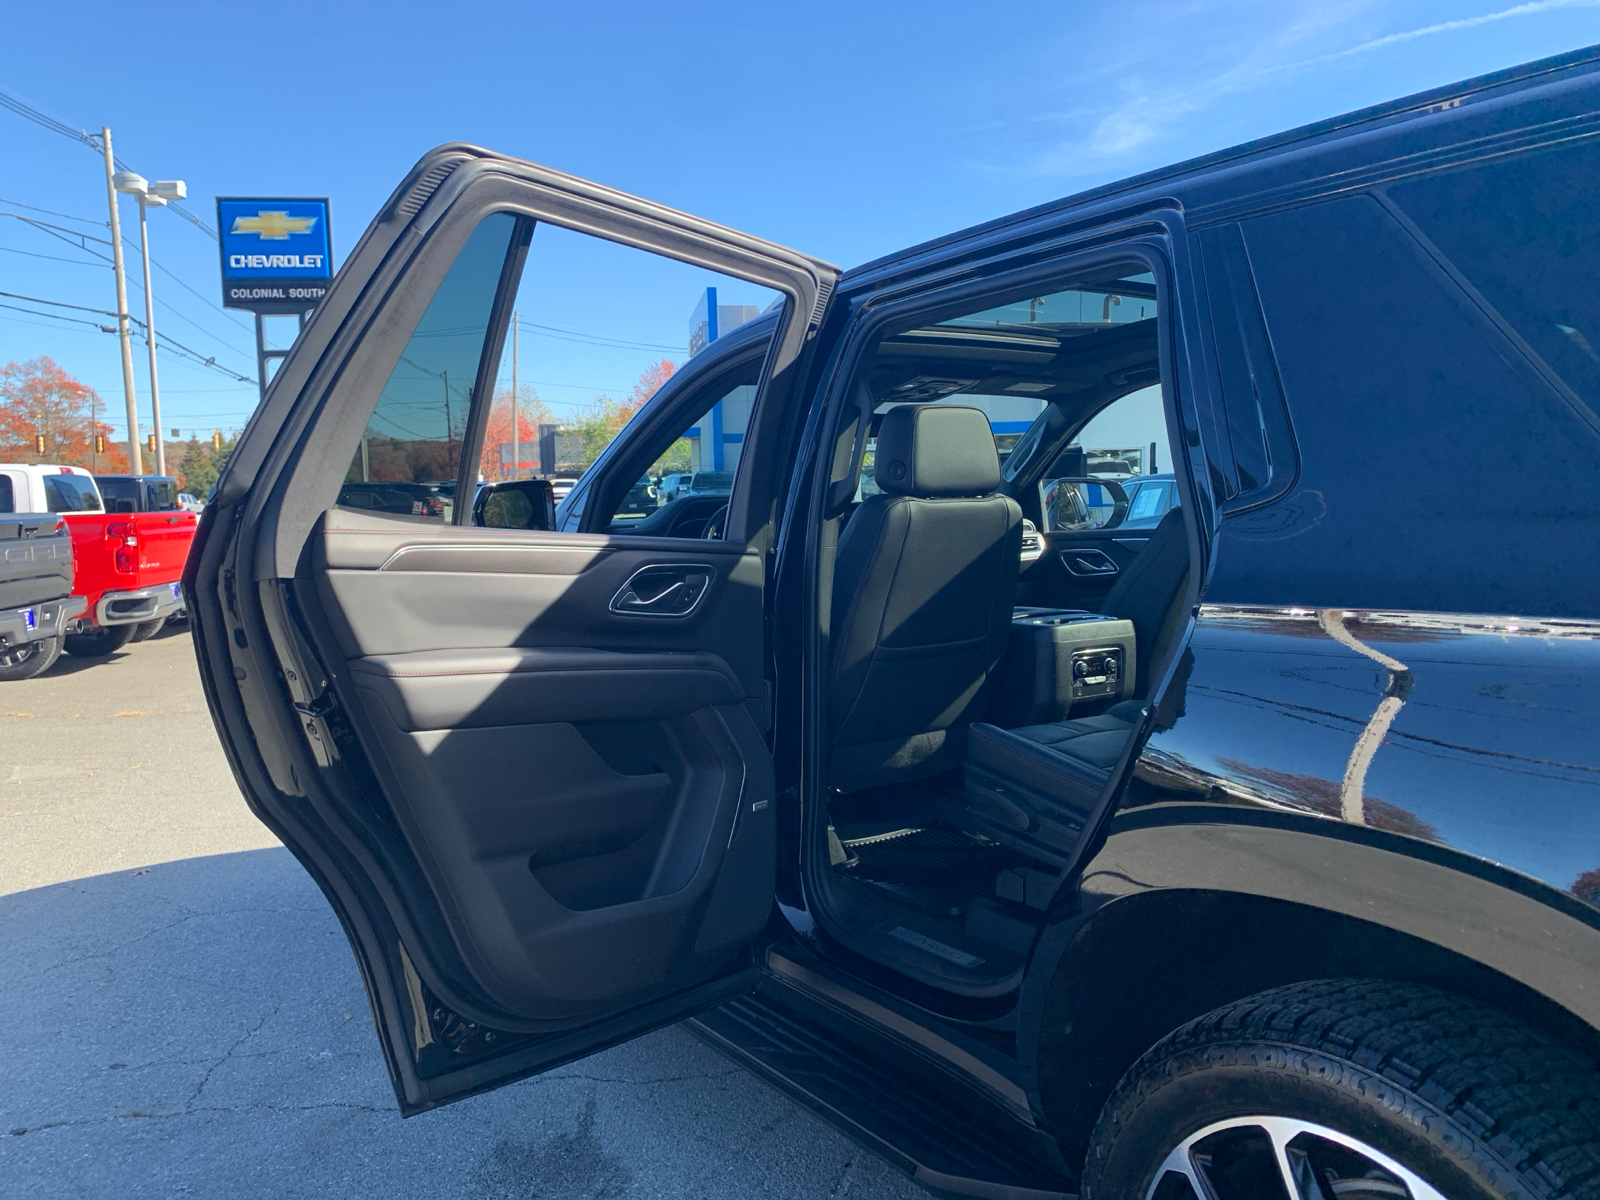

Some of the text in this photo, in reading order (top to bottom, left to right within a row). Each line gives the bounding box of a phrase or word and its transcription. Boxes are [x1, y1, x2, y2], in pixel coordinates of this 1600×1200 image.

[229, 254, 324, 268] CHEVROLET
[230, 288, 326, 298] COLONIAL SOUTH
